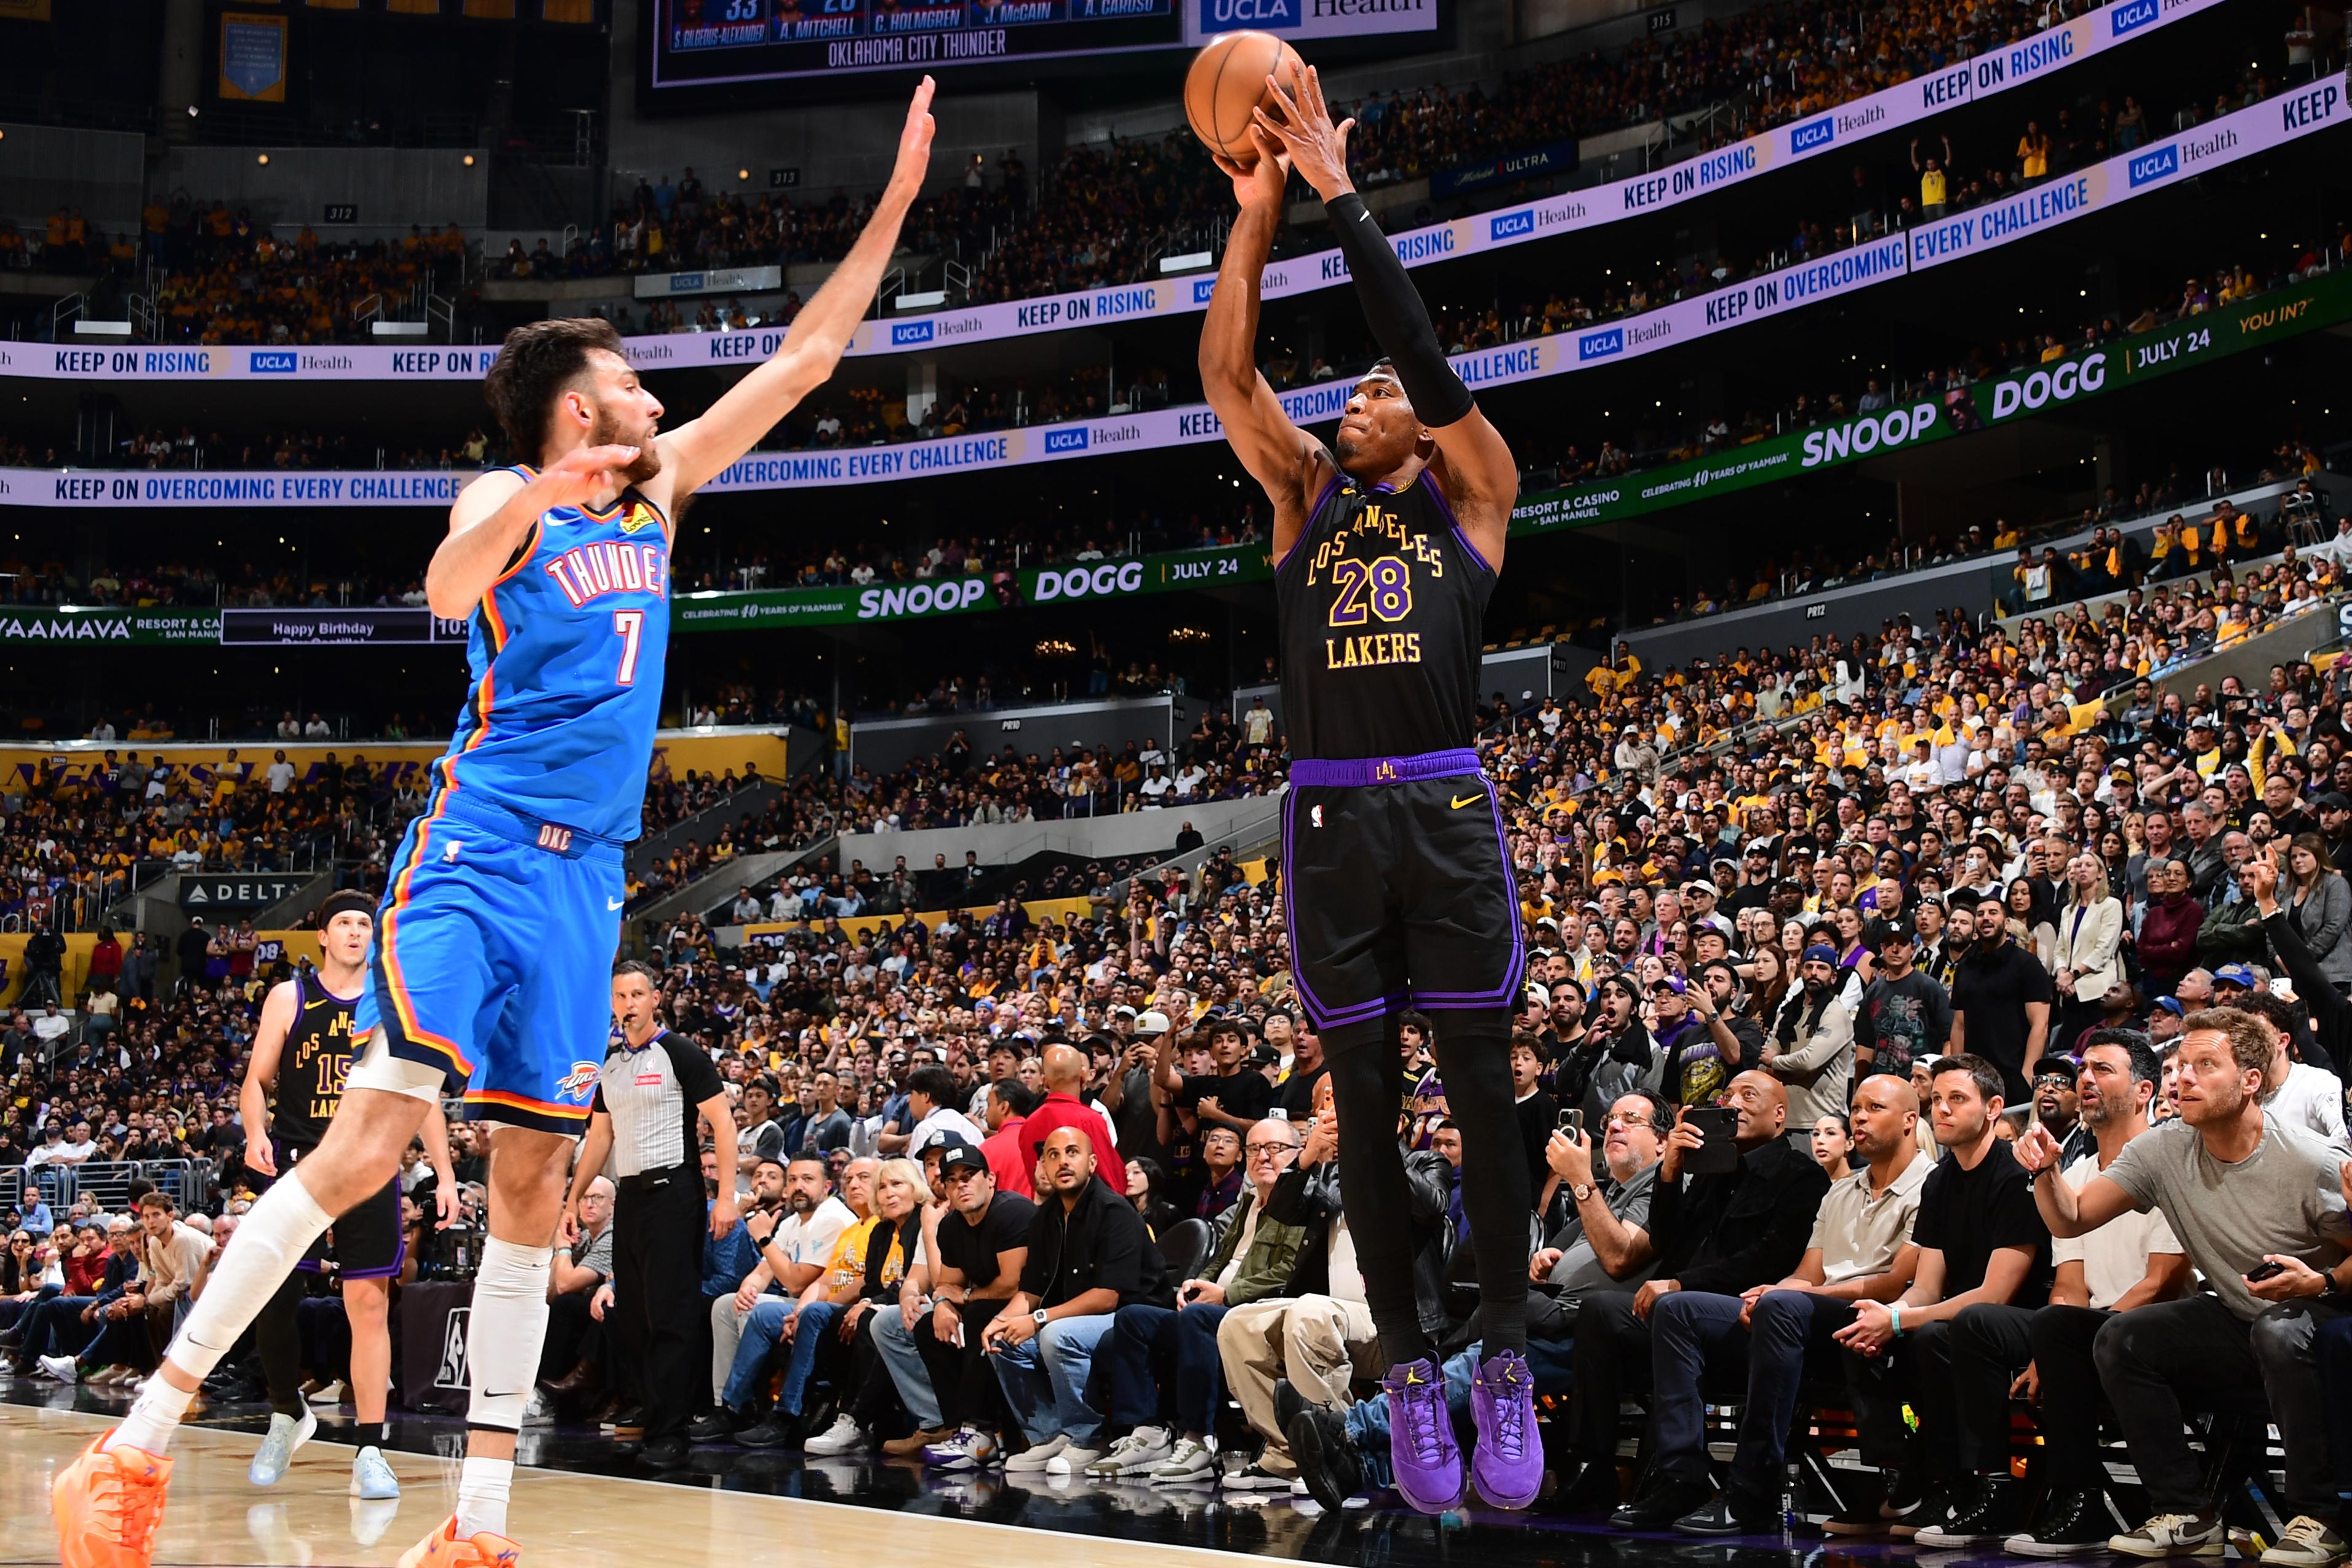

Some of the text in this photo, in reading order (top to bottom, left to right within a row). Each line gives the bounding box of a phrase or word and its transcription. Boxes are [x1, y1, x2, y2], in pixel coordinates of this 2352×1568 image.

[985, 2, 1052, 24] J. McCAIN
[1101, 0, 1154, 15] CARUSO
[1214, 0, 1289, 21] UCLA
[2117, 4, 2154, 29] UCLA
[779, 18, 855, 40] A. MITCHELL
[874, 9, 961, 32] C. HOLMGREN
[1651, 13, 1671, 31] 315
[828, 29, 1006, 67] OKLAHOMA CITY THUNDER
[1923, 29, 2074, 109] KEEP ON RISING
[2281, 84, 2338, 133] KEEP
[1795, 104, 1886, 149] UCLA Health
[1506, 152, 1549, 173] ULTRA
[2134, 130, 2239, 180] UCLA Health
[773, 171, 796, 186] 313
[1624, 145, 1757, 210] KEEP ON RISING
[329, 206, 353, 220] 312
[1496, 203, 1587, 235] UCLA Health
[1397, 229, 1455, 262] RISING
[1706, 177, 2090, 326] KEEP ON OVERCOMING EVERY CHALLENGE
[674, 270, 745, 289] UCLA Health
[1261, 271, 1289, 291] alth
[1018, 289, 1156, 327] KEEP ON RISING
[2239, 299, 2308, 334] YOU IN?
[897, 317, 983, 341] UCLA Health
[1584, 320, 1671, 355] UCLA Health
[710, 336, 756, 359] KEEP
[2137, 327, 2211, 369] JULY 24
[55, 351, 211, 373] KEEP ON RISING
[256, 356, 354, 371] UCLA Health
[393, 353, 443, 373] KEEP
[447, 353, 473, 373] ON
[1453, 347, 1540, 383] ALLENGE
[1280, 384, 1356, 419] ERCOMI
[1800, 352, 2107, 469] SNOOP DOGG
[1050, 424, 1141, 450] UCLA Health
[720, 437, 1008, 485] OVERCOMING EVERY CHALLENGE
[55, 477, 461, 501] KEEP ON OVERCOMING EVERY CHALLENGE
[1641, 478, 1692, 499] CELEBRATING
[1692, 469, 1709, 488] 40
[1710, 467, 1736, 481] YEARS
[1737, 464, 1747, 474] OF
[1512, 490, 1620, 520] RESORT & CASINO
[1539, 514, 1560, 526] SAN
[1561, 507, 1601, 521] MANUEL
[1172, 558, 1238, 581] JULY 24
[1307, 530, 1348, 586] LOS
[858, 561, 1144, 618] SNOOP DOGG
[1328, 555, 1413, 628] 28
[682, 608, 738, 620] CELEBRATING
[741, 603, 759, 619] 40
[760, 606, 787, 615] YEARS
[788, 604, 800, 614] OF
[1807, 603, 1826, 618] PR12
[137, 618, 188, 630] RESORT
[190, 618, 199, 630] &
[166, 630, 186, 639] SAN
[188, 630, 221, 639] MANU
[273, 622, 375, 638] Happy Birthday
[614, 609, 644, 687] 7
[1326, 631, 1421, 670] LAKERS
[1002, 719, 1020, 731] PR10
[1376, 760, 1397, 781] LAL
[537, 824, 572, 853] OKC
[259, 943, 279, 961] 08
[295, 1032, 321, 1069] LOS
[316, 1053, 353, 1095] 15
[310, 1099, 339, 1119] LAK
